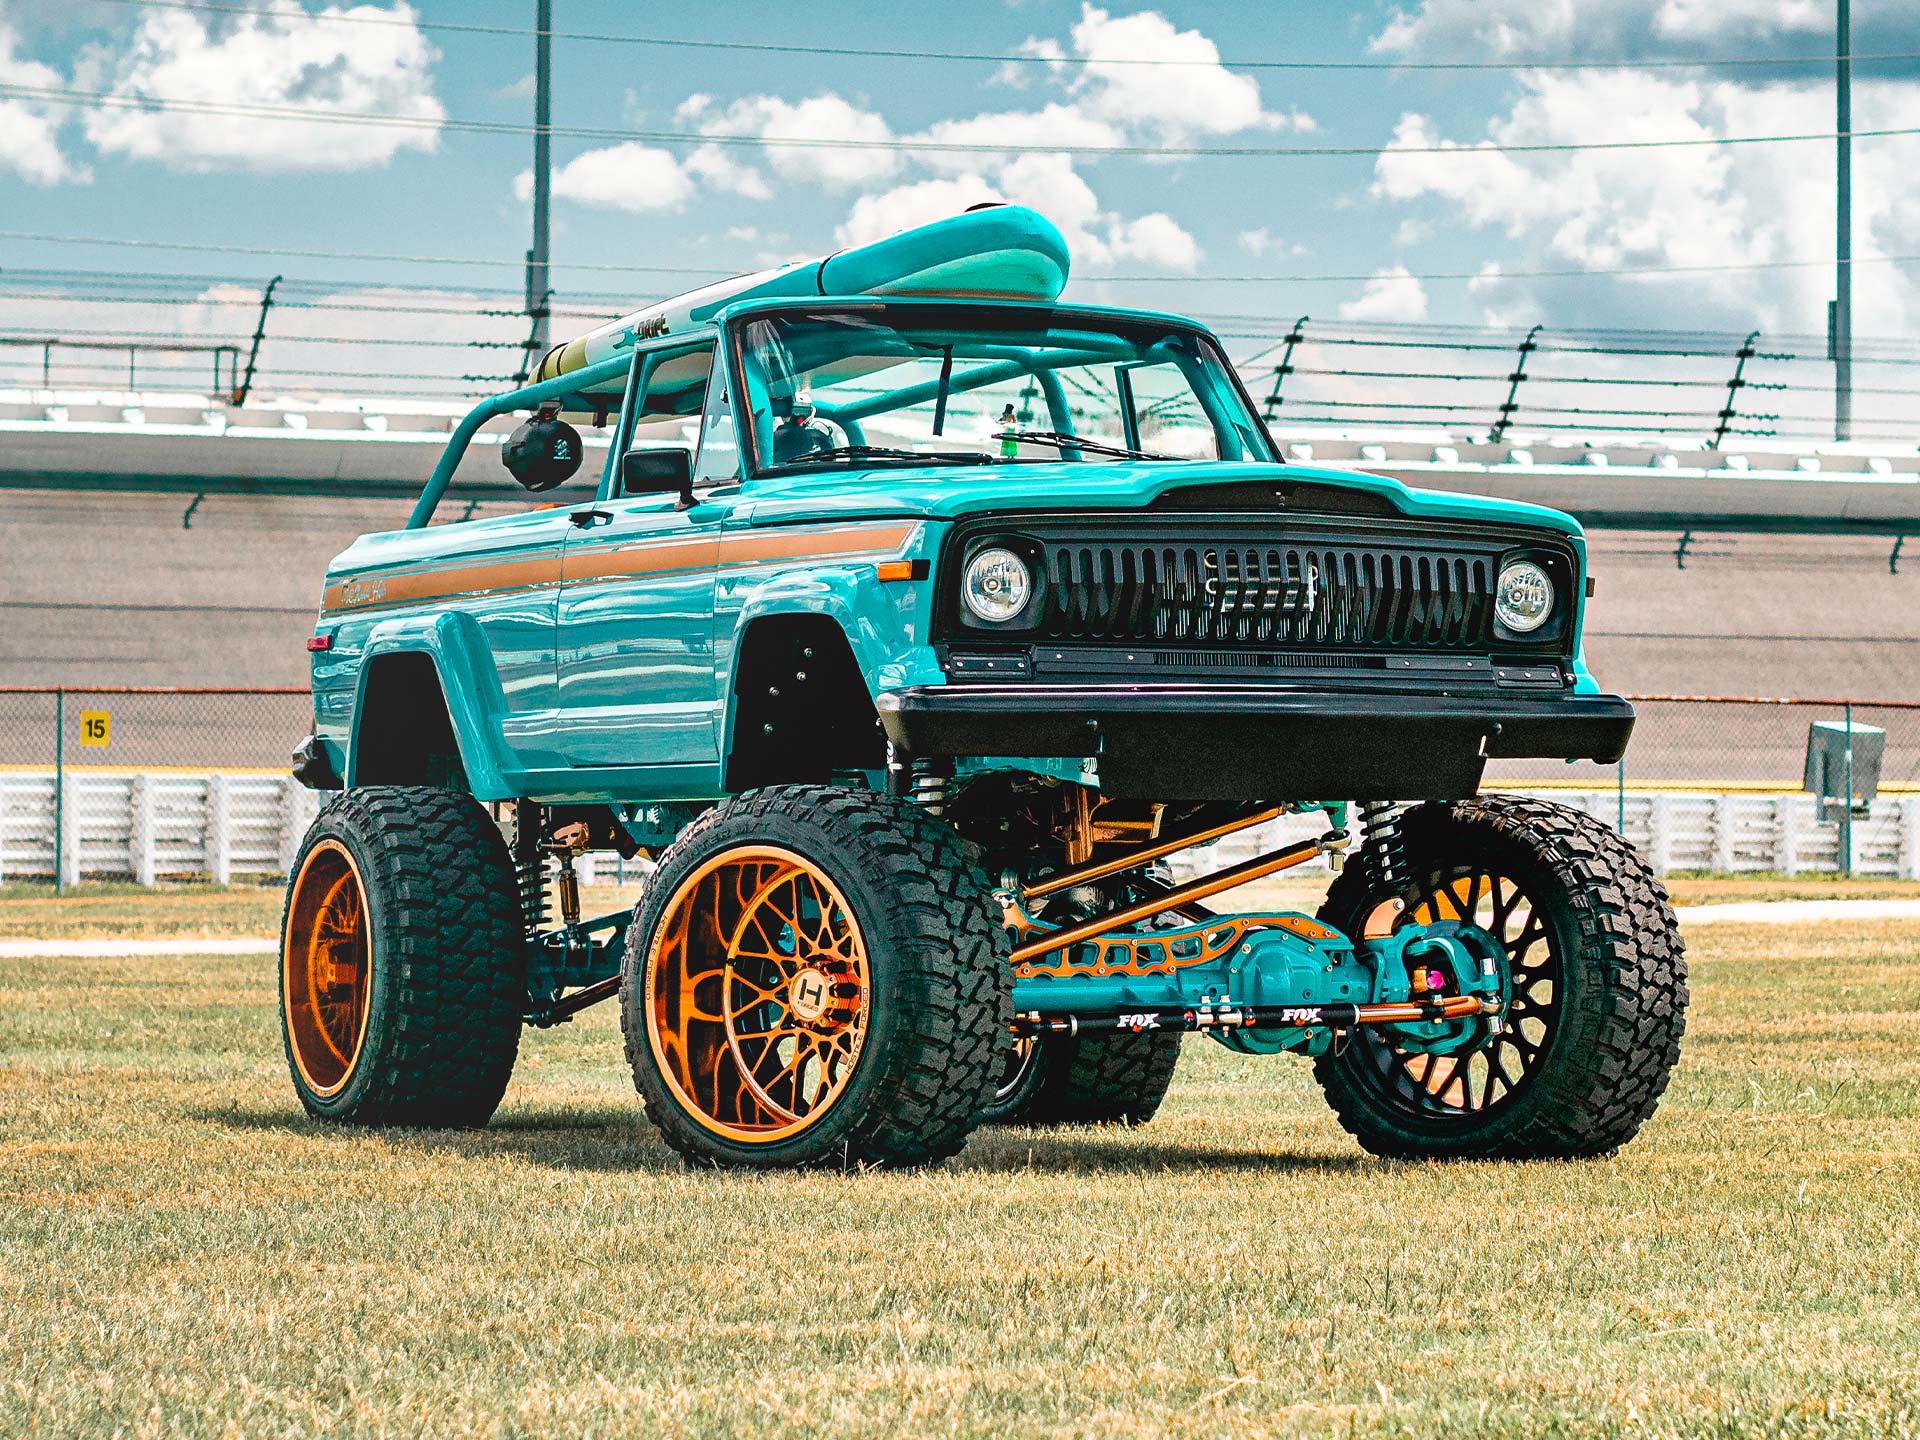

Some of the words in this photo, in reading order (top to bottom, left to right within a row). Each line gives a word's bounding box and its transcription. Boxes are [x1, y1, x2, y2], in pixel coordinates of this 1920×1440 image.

[85, 719, 105, 738] 15
[799, 979, 822, 1006] H
[797, 1000, 819, 1012] FORGED
[1117, 1013, 1161, 1030] FOX
[1281, 1008, 1323, 1025] FOX
[846, 1034, 863, 1075] HOSTILE
[860, 988, 868, 1029] FORGED
